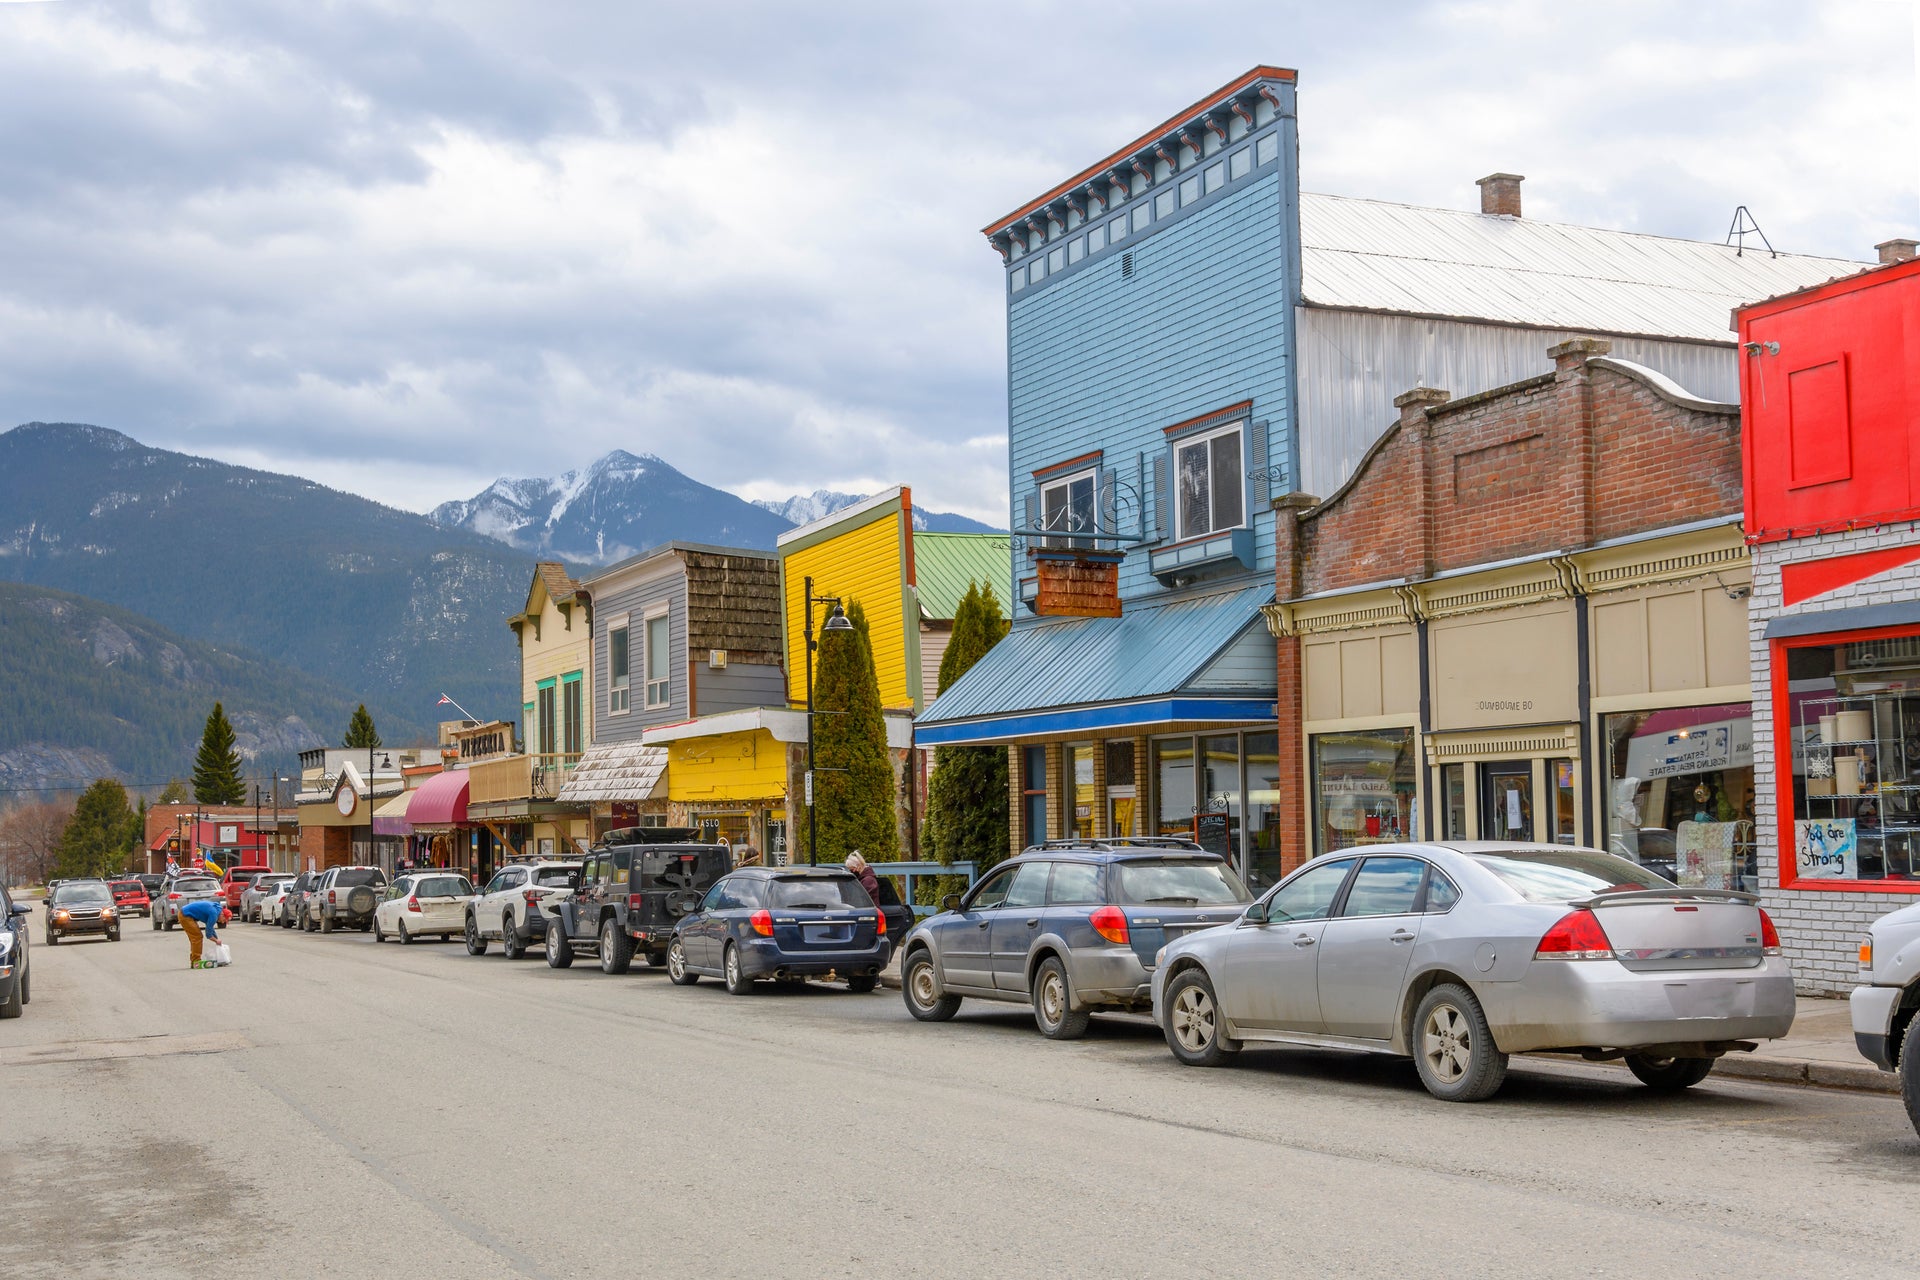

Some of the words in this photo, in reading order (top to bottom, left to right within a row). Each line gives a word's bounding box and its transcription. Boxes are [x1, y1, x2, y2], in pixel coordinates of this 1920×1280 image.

[461, 732, 505, 757] PIZZERIA
[695, 819, 720, 827] KASLO
[1803, 823, 1823, 841] You
[1827, 828, 1845, 842] are
[1801, 846, 1845, 875] Strong
